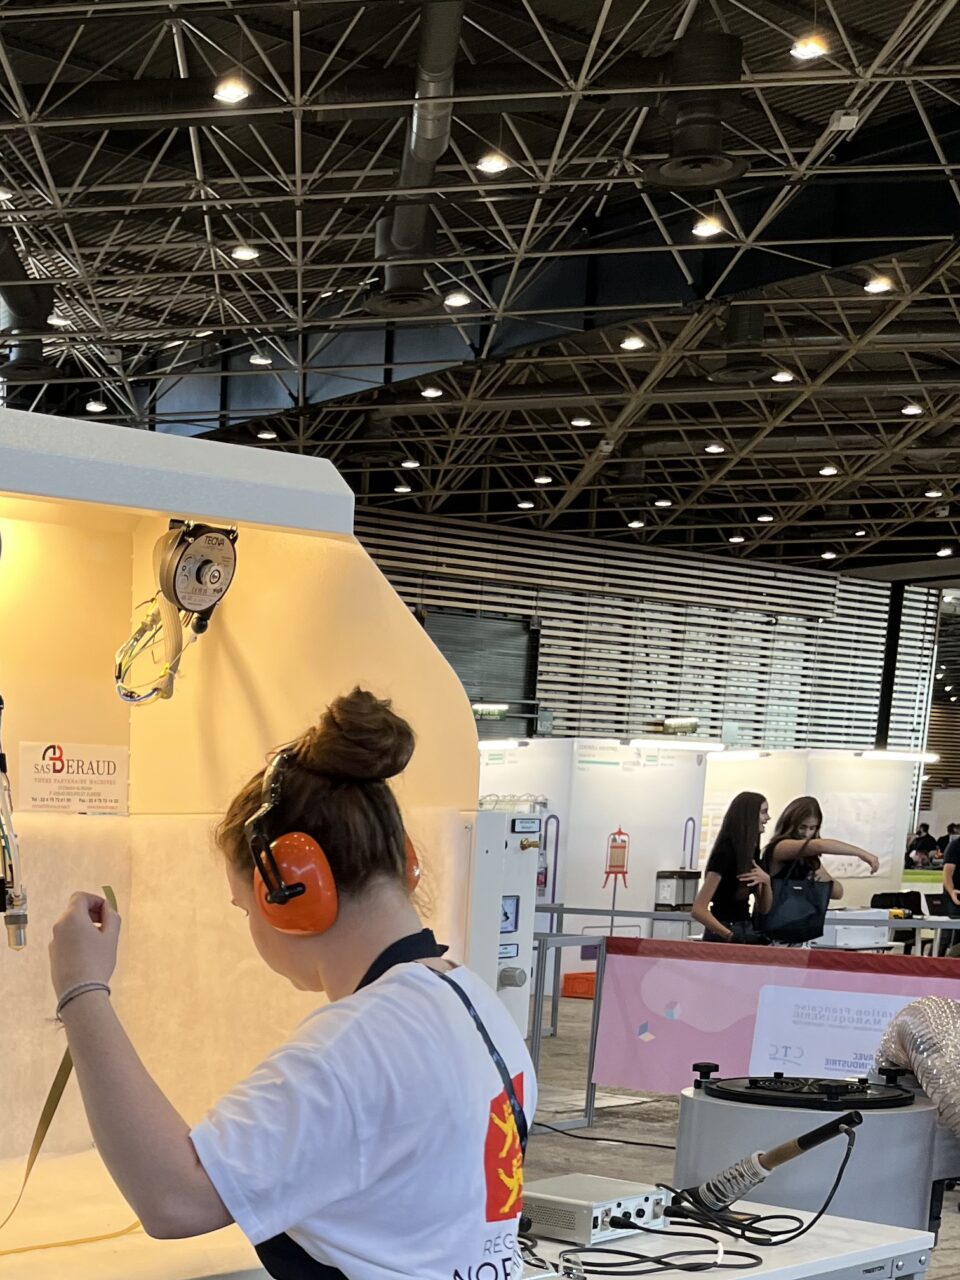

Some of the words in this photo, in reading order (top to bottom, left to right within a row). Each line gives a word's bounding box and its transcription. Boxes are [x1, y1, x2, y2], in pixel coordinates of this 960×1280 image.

[205, 535, 225, 547] TECNA
[34, 763, 51, 774] SAS
[49, 745, 117, 776] BERAUD
